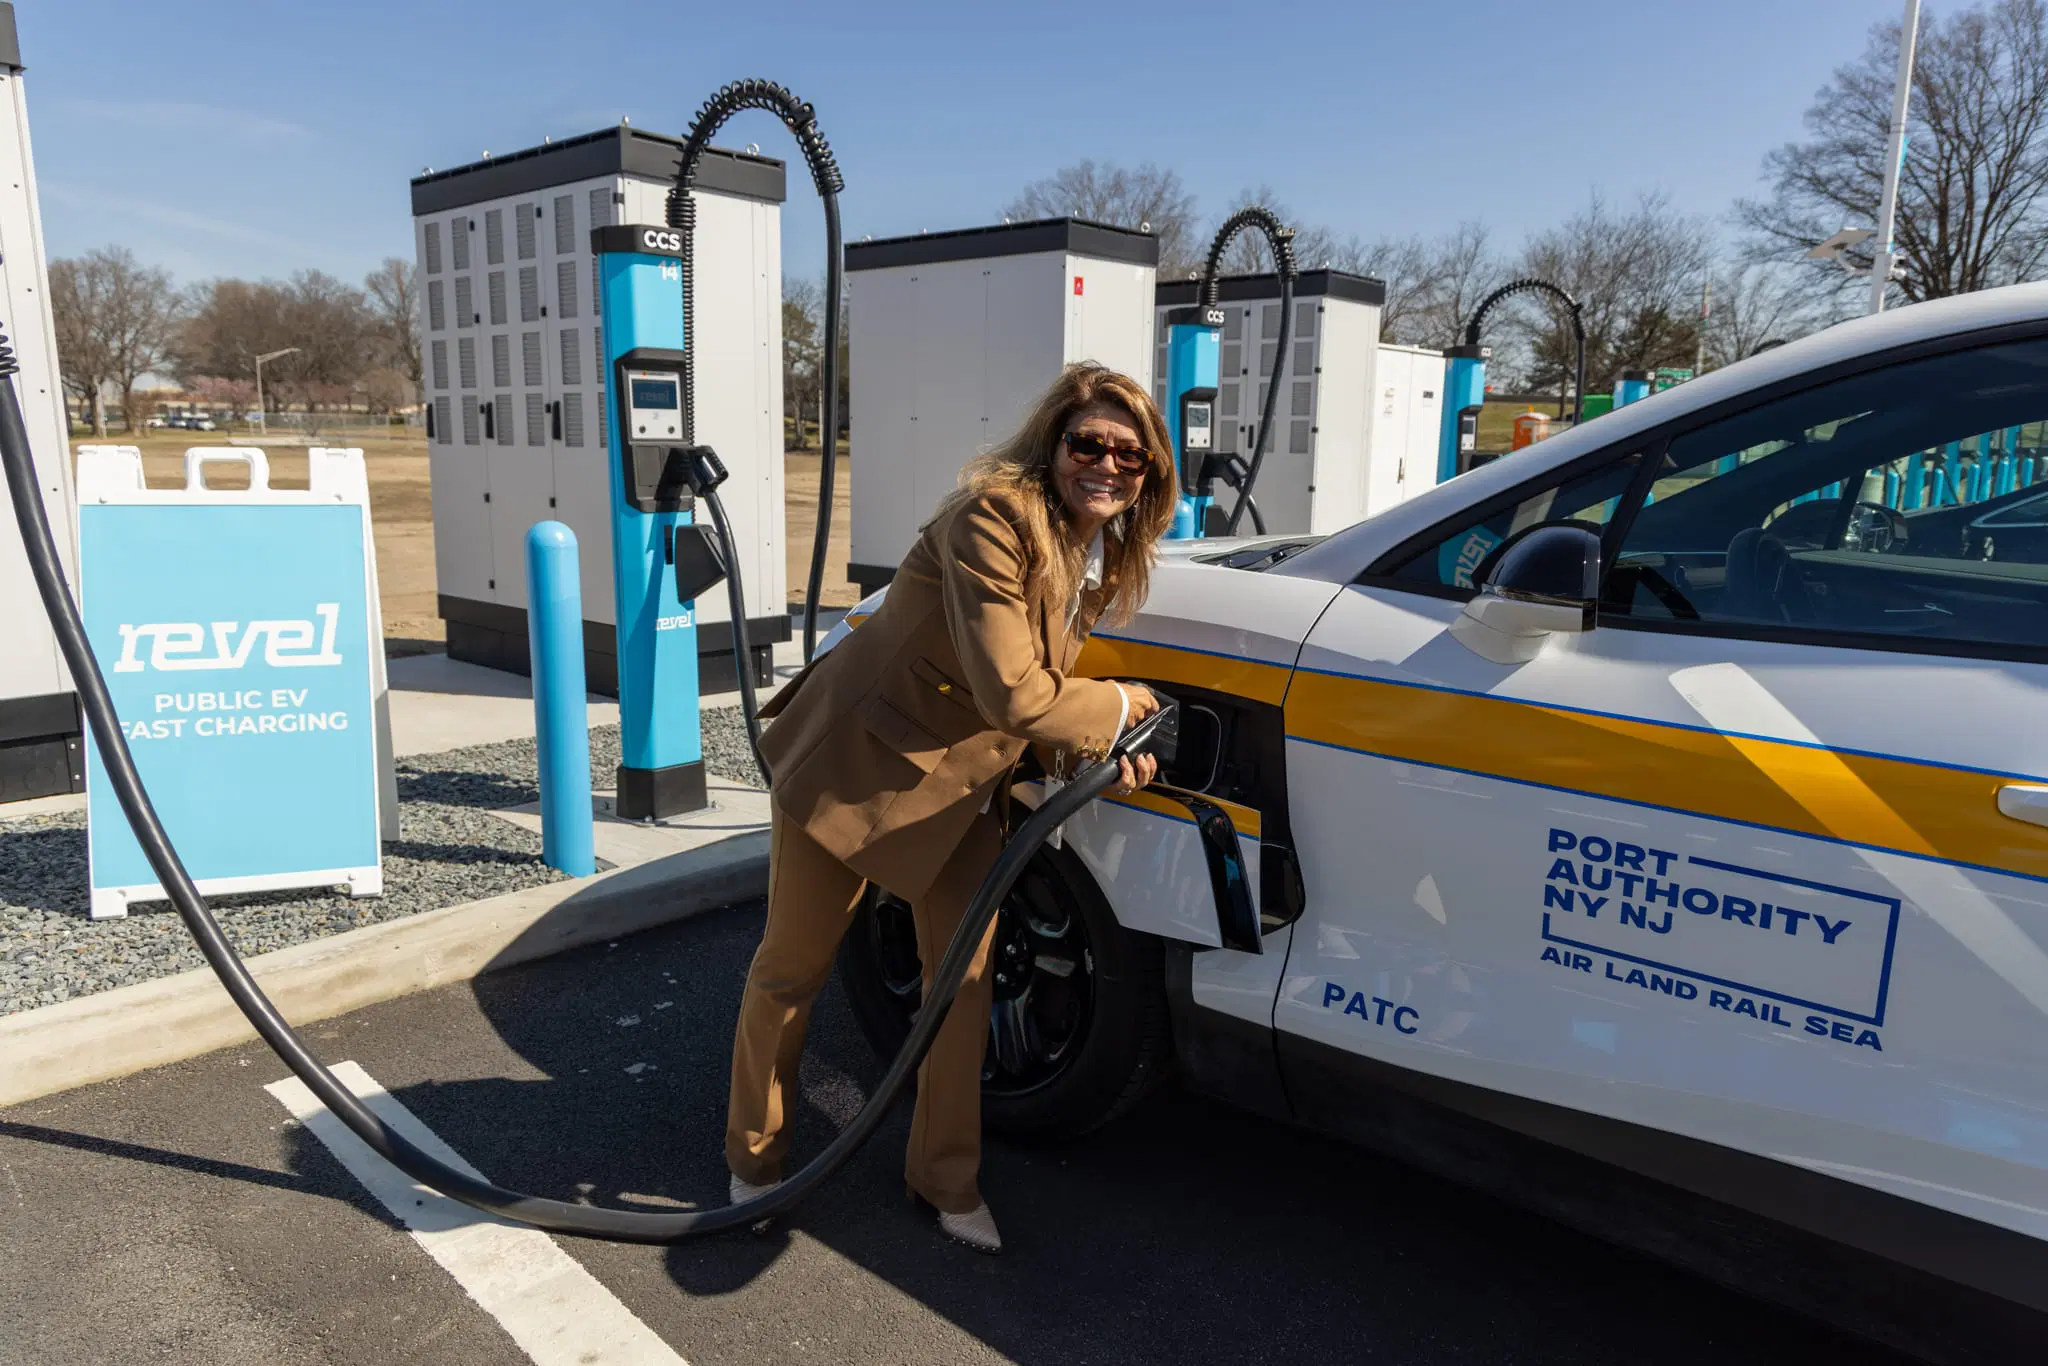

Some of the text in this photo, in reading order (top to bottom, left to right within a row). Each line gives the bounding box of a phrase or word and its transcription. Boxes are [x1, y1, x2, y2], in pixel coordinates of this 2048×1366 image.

[643, 229, 681, 251] CCS
[658, 260, 679, 281] 14
[1207, 309, 1225, 324] CCS
[113, 603, 343, 673] revel
[656, 610, 693, 631] revel
[155, 688, 308, 713] PUBLIC EV
[194, 711, 348, 737] CHARGING
[1547, 827, 1679, 877] PORT
[1543, 883, 1673, 935] NY NJ
[1546, 857, 1852, 945] AUTHORITY
[1322, 981, 1420, 1035] PATC
[1540, 946, 1883, 1052] AIR LAND RAIL SEA
